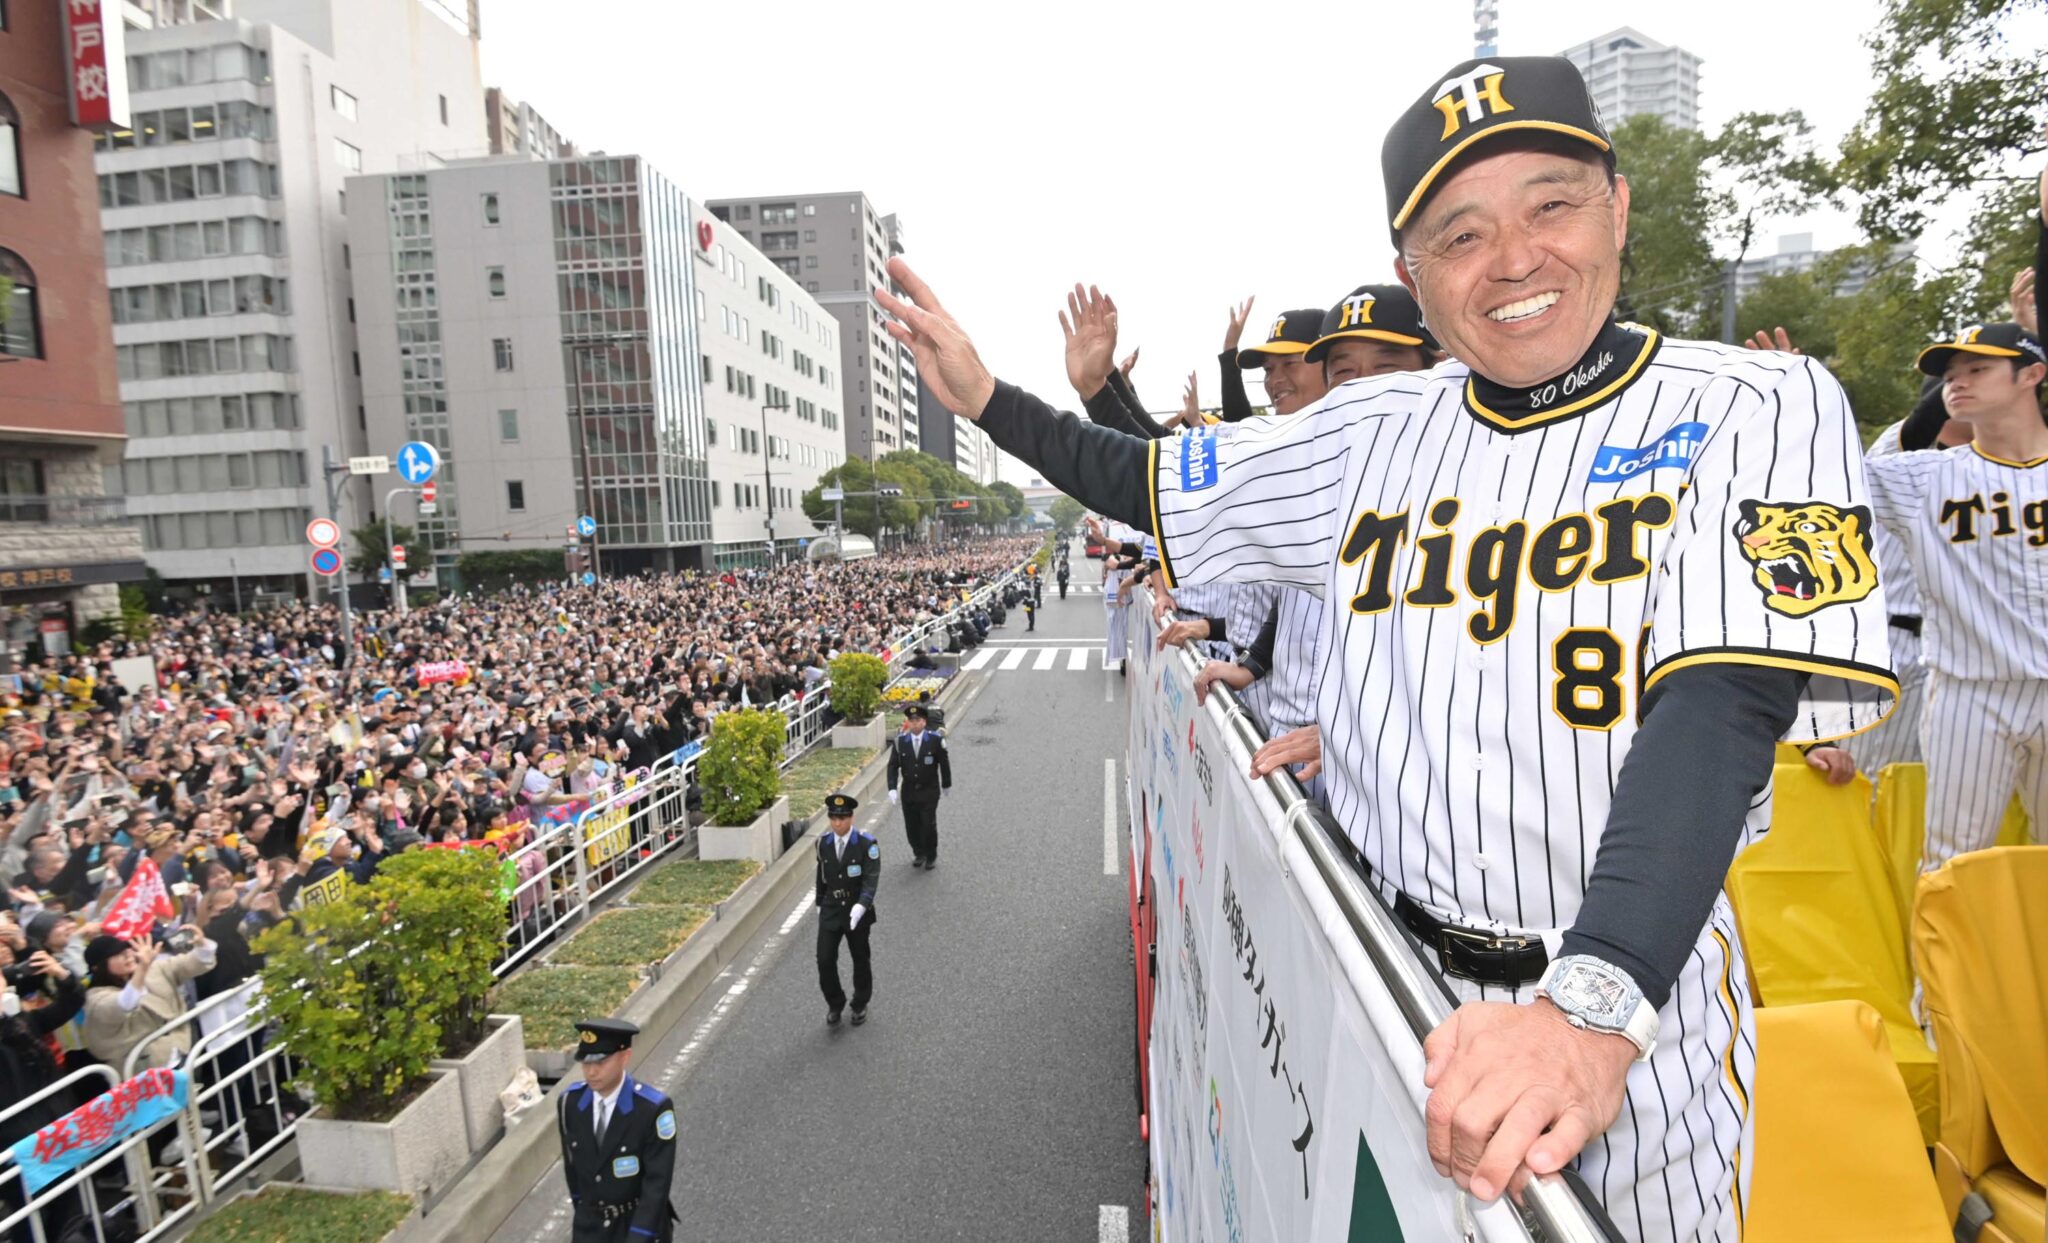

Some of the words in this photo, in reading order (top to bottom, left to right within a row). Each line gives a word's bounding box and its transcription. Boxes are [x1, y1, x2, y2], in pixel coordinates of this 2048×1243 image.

[1530, 384, 1557, 408] 80
[1562, 350, 1615, 396] Okada
[1551, 624, 1652, 732] 8
[1222, 861, 1315, 1201] 阪神タイガース
